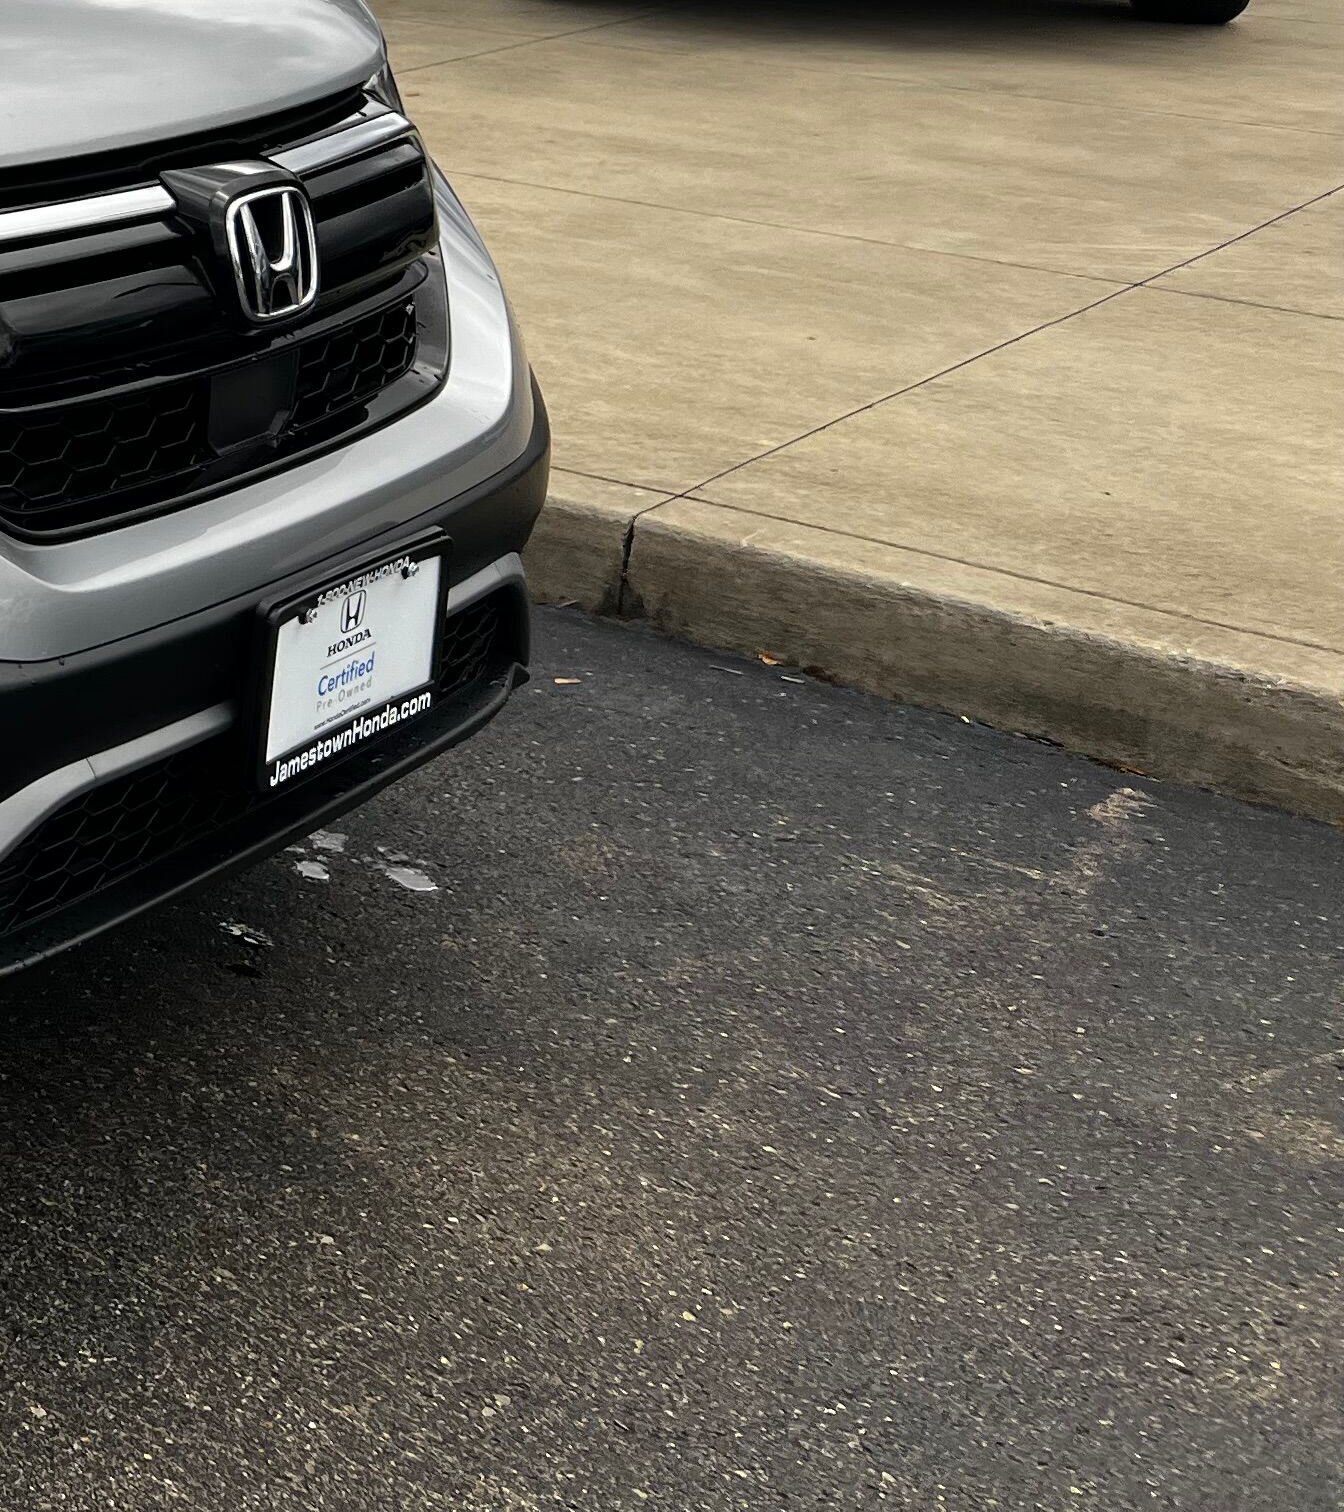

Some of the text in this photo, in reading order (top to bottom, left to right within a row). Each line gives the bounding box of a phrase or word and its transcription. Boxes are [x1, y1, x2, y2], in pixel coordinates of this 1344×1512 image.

[326, 627, 373, 658] HONDA
[317, 650, 376, 697] Certified
[269, 691, 432, 787] JamestownHonda.com
